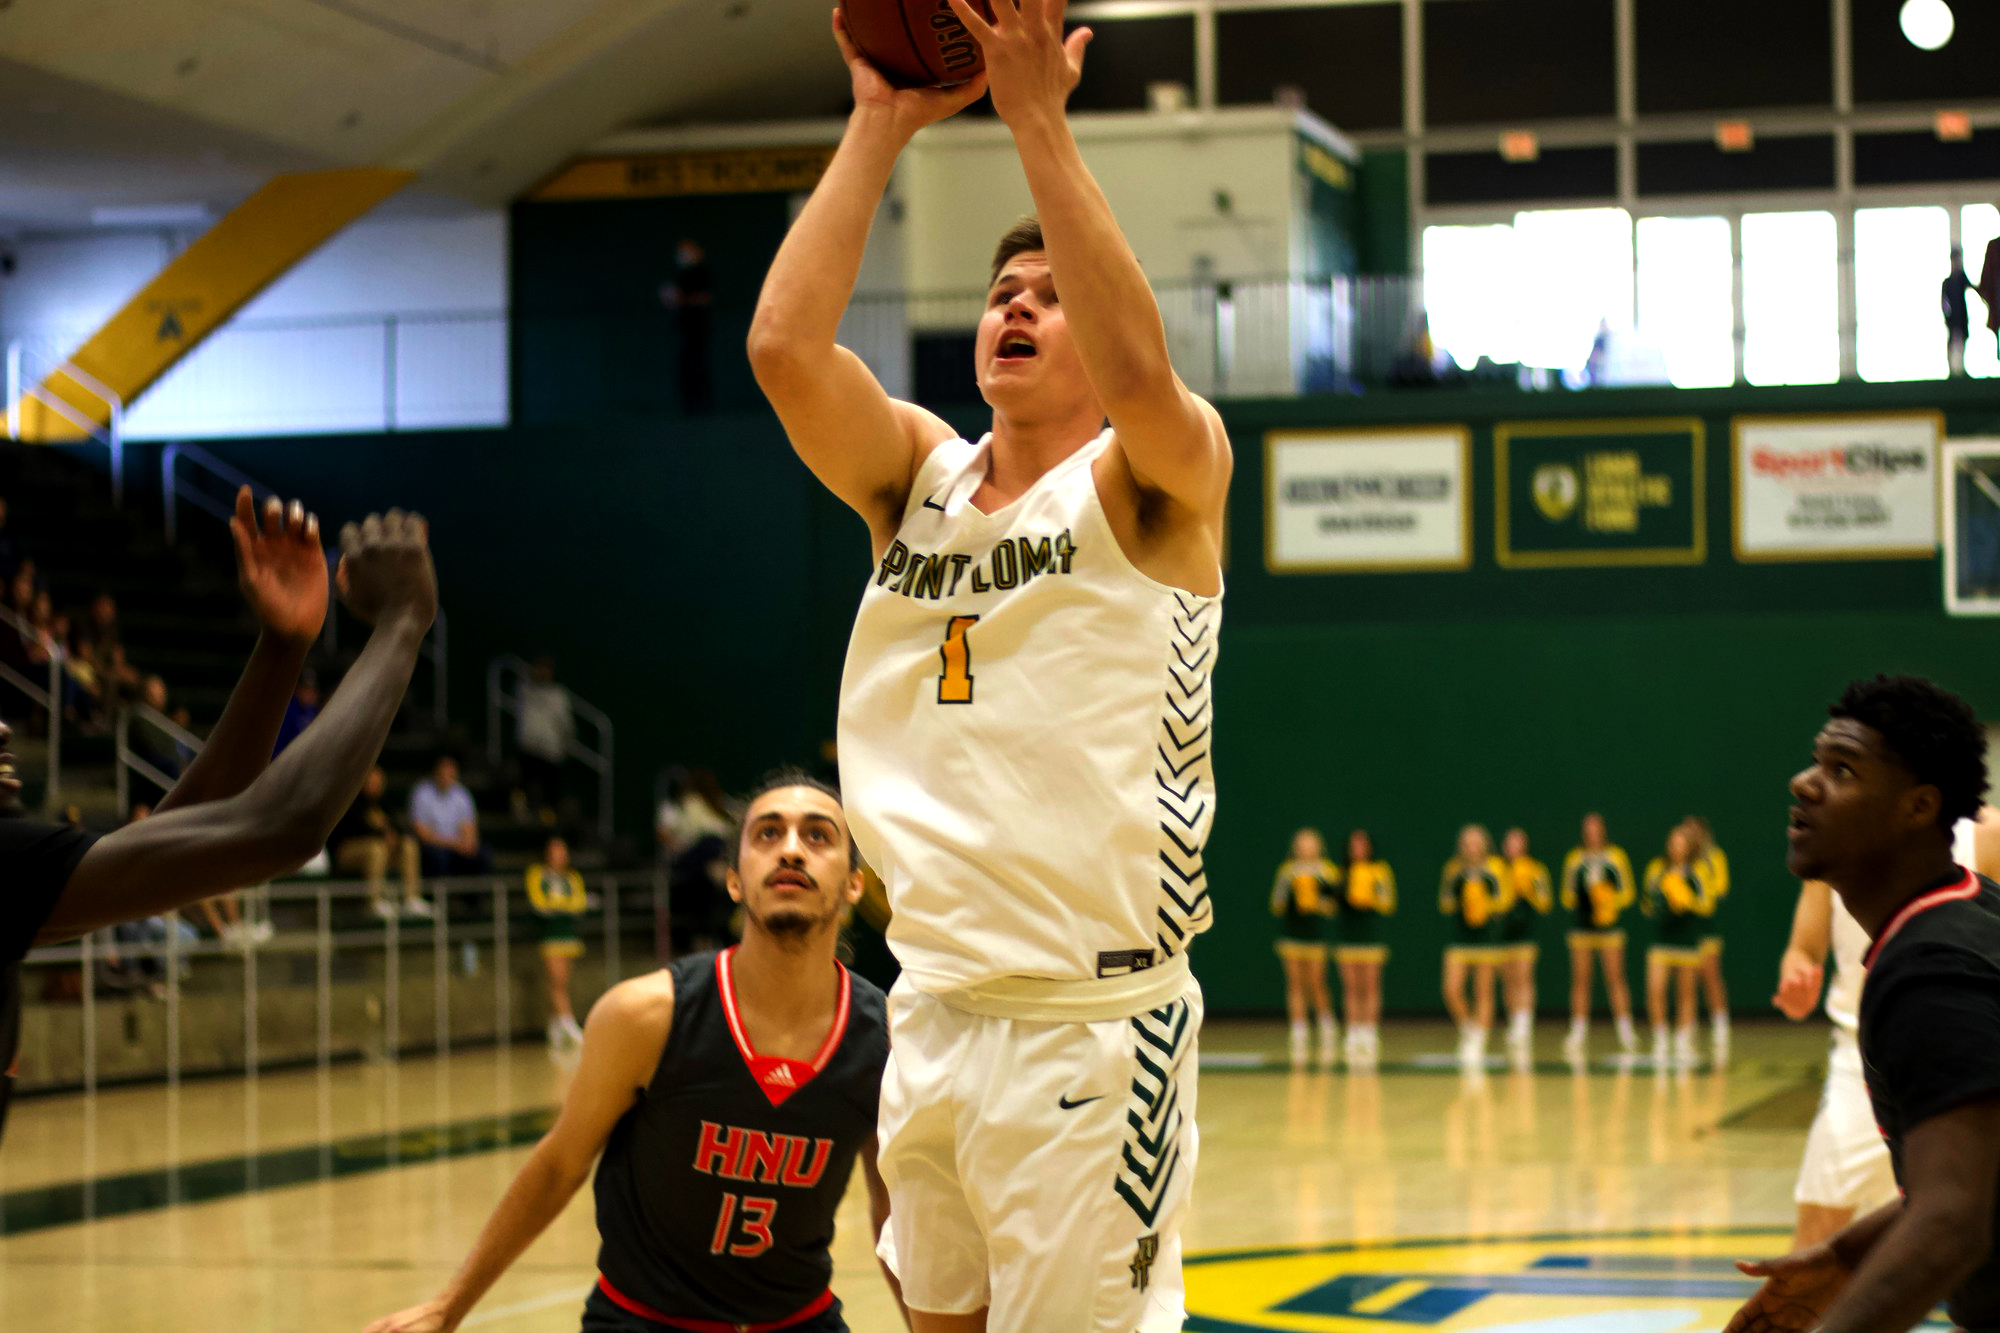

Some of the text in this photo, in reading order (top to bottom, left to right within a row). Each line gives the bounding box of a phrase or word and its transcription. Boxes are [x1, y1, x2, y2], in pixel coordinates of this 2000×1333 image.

[971, 528, 1078, 593] LOMA
[937, 614, 981, 704] 1
[692, 1120, 835, 1188] HNU
[710, 1192, 778, 1258] 13
